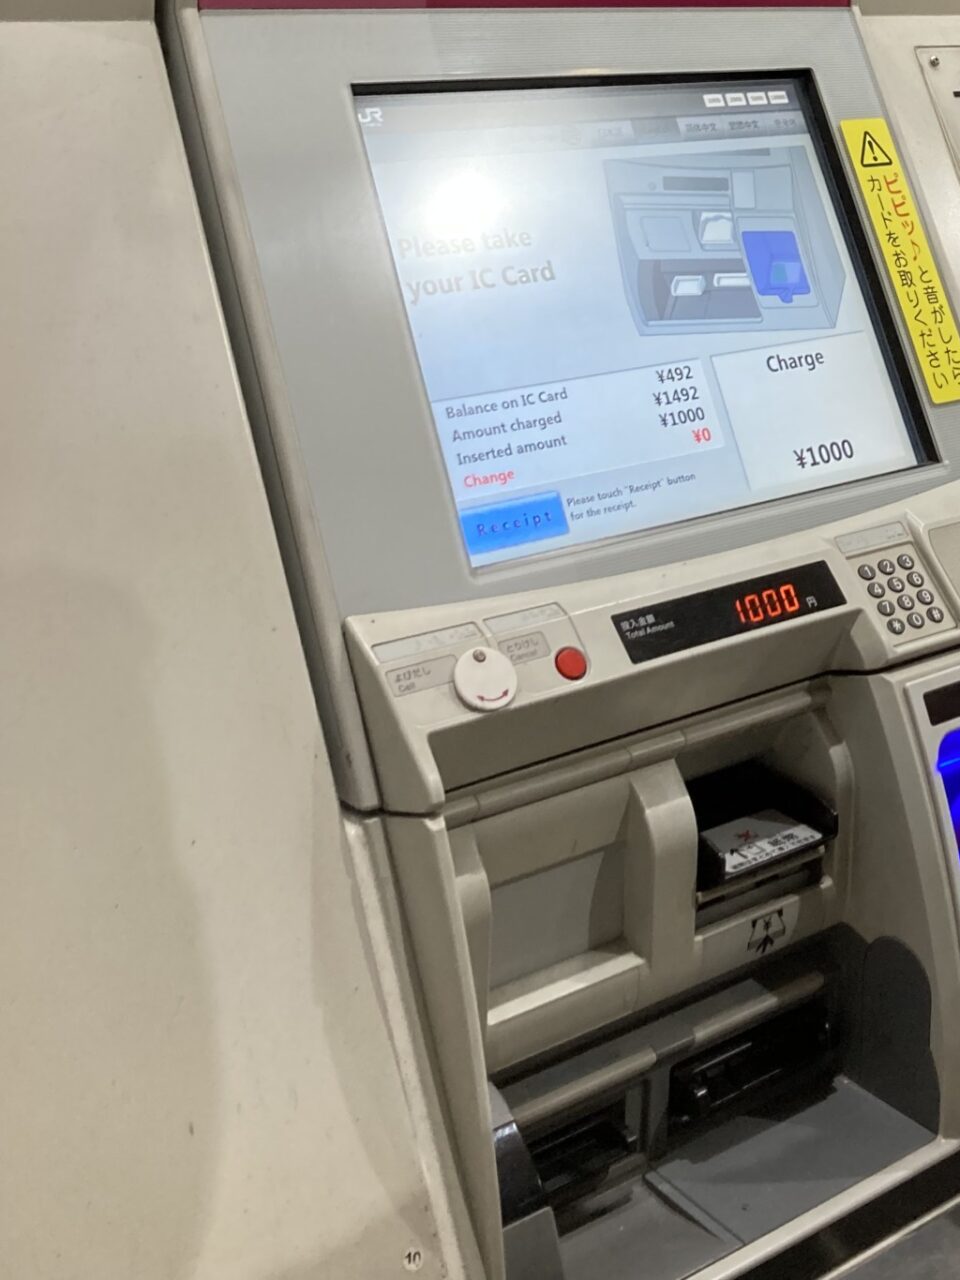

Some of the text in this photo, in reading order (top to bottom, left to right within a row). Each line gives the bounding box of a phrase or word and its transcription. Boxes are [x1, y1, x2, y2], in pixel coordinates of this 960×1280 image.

[398, 227, 533, 259] Please take
[406, 260, 556, 306] your IC Card
[766, 354, 825, 372] Charge
[655, 365, 694, 384] ¥492
[445, 387, 569, 419] Balance on IC Card
[652, 386, 700, 407] ¥1492
[452, 411, 563, 443] Amount charged
[658, 407, 706, 428] ¥1000
[692, 427, 712, 444] ¥0
[456, 434, 568, 466] Inserted amount
[793, 439, 854, 469] ¥1000
[463, 469, 515, 489] Change
[566, 495, 595, 507] Please
[597, 488, 623, 501] touch
[666, 473, 696, 486] button
[476, 510, 554, 538] Receipt
[570, 511, 585, 521] for
[586, 505, 602, 517] the
[863, 556, 911, 577] 1 2 3
[873, 574, 921, 596] 4 5 6
[735, 583, 800, 624] 1000
[882, 591, 931, 614] 7 8 9
[912, 615, 921, 626] 0
[625, 628, 646, 640] Total
